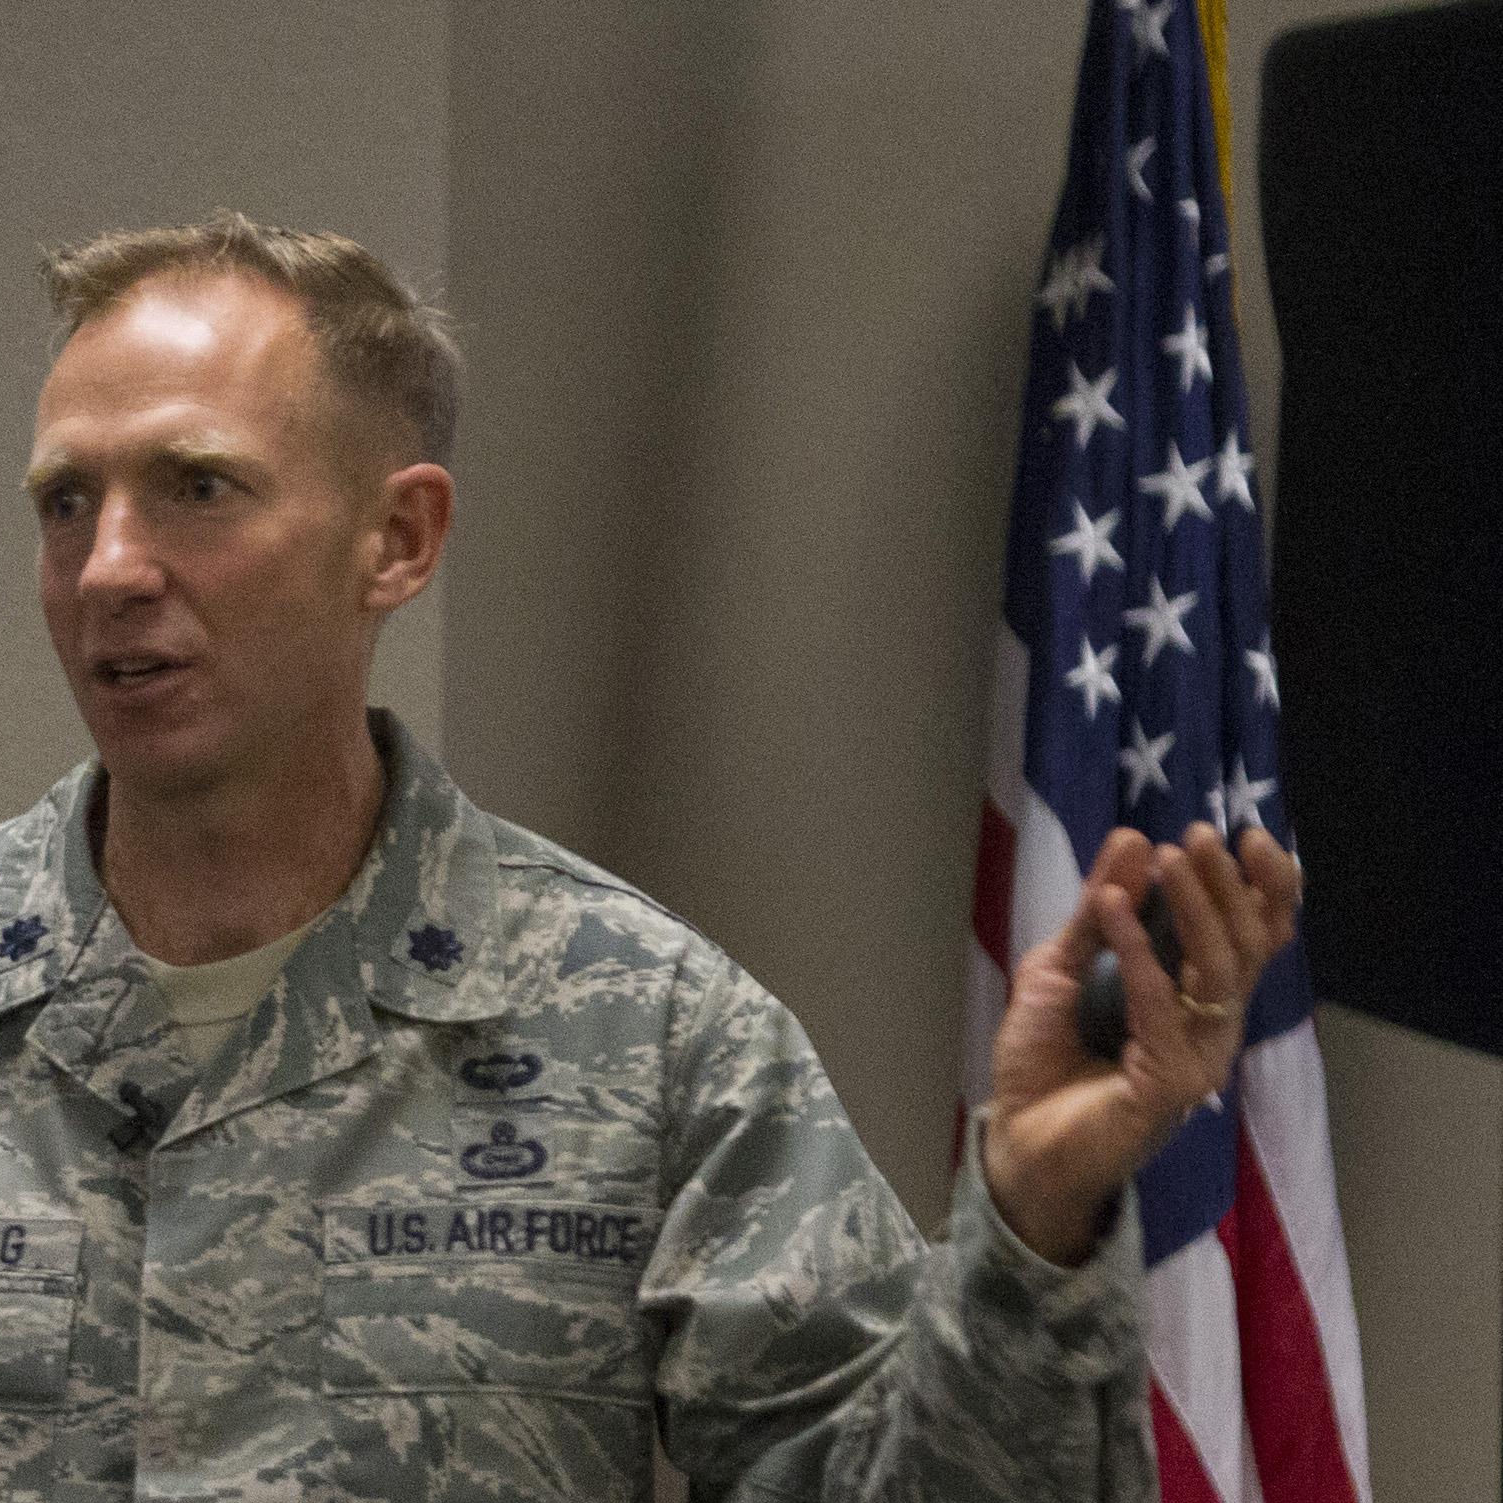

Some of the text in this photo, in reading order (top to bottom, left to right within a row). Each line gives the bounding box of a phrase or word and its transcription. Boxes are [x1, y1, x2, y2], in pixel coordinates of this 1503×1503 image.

[367, 1208, 642, 1260] U.S. AIR FORCE
